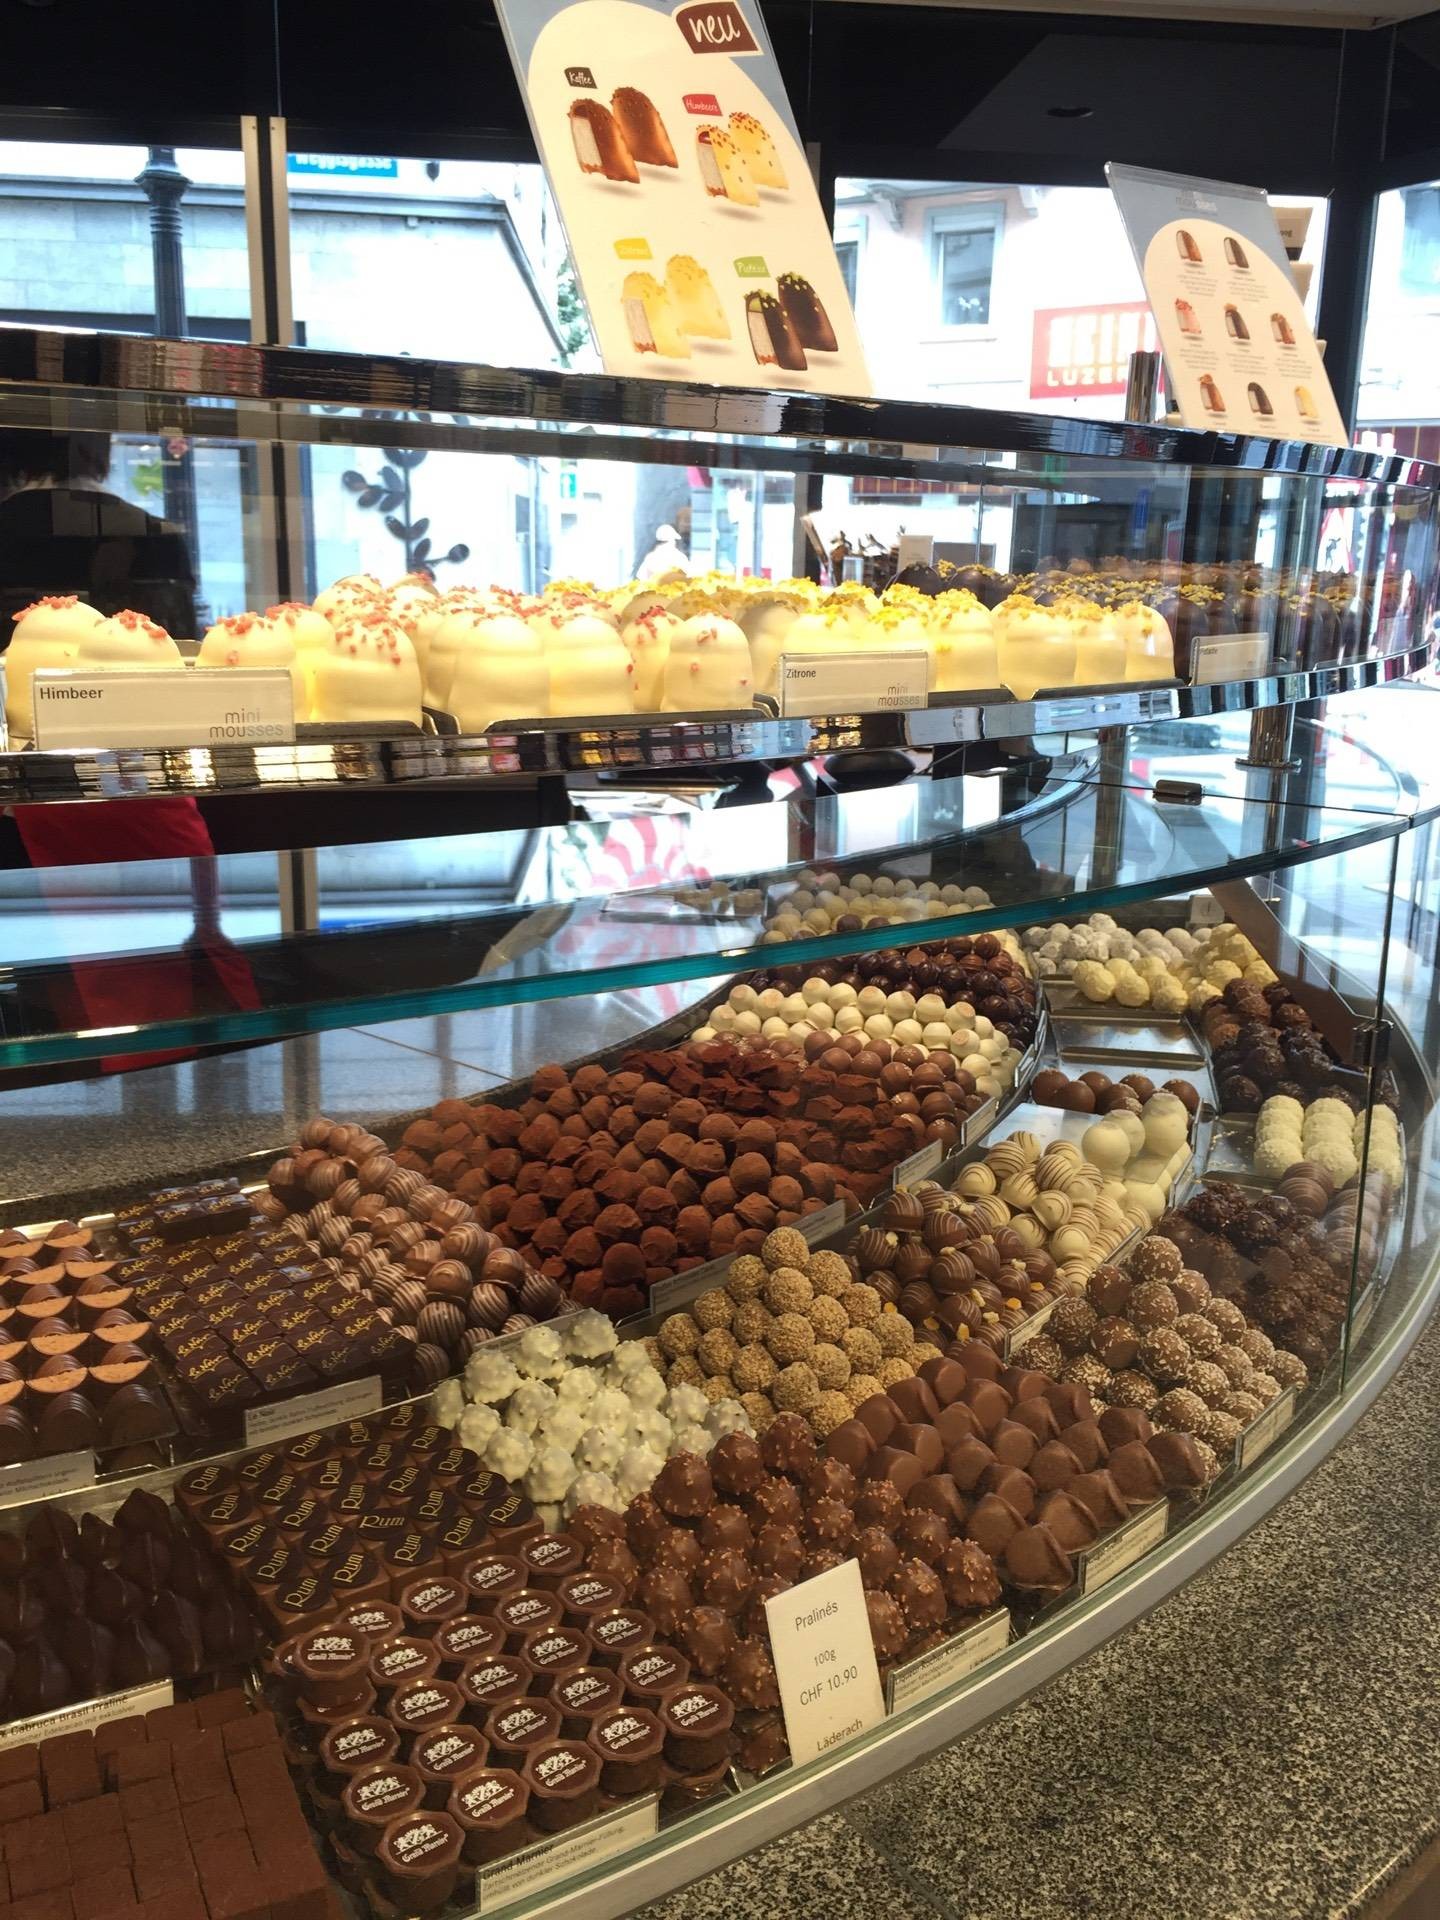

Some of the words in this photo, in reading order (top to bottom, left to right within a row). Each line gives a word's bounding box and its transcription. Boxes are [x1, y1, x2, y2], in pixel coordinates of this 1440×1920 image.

[689, 14, 742, 45] neu
[786, 668, 817, 679] Zitrone
[39, 686, 104, 701] Himbeer
[877, 693, 920, 707] mousses
[225, 707, 261, 724] mini
[209, 723, 285, 738] mousses
[390, 1405, 414, 1426] Rum
[290, 1433, 322, 1457] Rum
[349, 1421, 370, 1443] Rum
[412, 1426, 440, 1449] Rum
[241, 1453, 275, 1478] Rum
[368, 1443, 392, 1467] Rum
[438, 1449, 464, 1472] Rum
[190, 1465, 220, 1491] Rum
[320, 1460, 343, 1484] Rum
[387, 1466, 419, 1492] Rum
[466, 1471, 494, 1495] Rum
[263, 1474, 295, 1501] Rum
[341, 1484, 366, 1509] Rum
[210, 1494, 240, 1520] Rum
[282, 1499, 317, 1527] Rum
[418, 1490, 444, 1516] Rum
[489, 1496, 522, 1522] Rum
[358, 1515, 405, 1529] Rum
[443, 1517, 475, 1545] Rum
[228, 1523, 267, 1552] Rum
[309, 1524, 344, 1552] Rum
[393, 1534, 422, 1562] Rum
[256, 1550, 290, 1578] Rum
[332, 1553, 364, 1583] Rum
[283, 1578, 319, 1607] Rum
[795, 1601, 839, 1631] Pralinés
[813, 1648, 838, 1667] 100g
[799, 1682, 824, 1707] CHF
[827, 1665, 859, 1692] 10.90
[59, 1706, 89, 1722] Brasil
[816, 1719, 863, 1751] Läderach
[481, 1860, 513, 1881] Grand
[515, 1844, 555, 1866] Marnier
